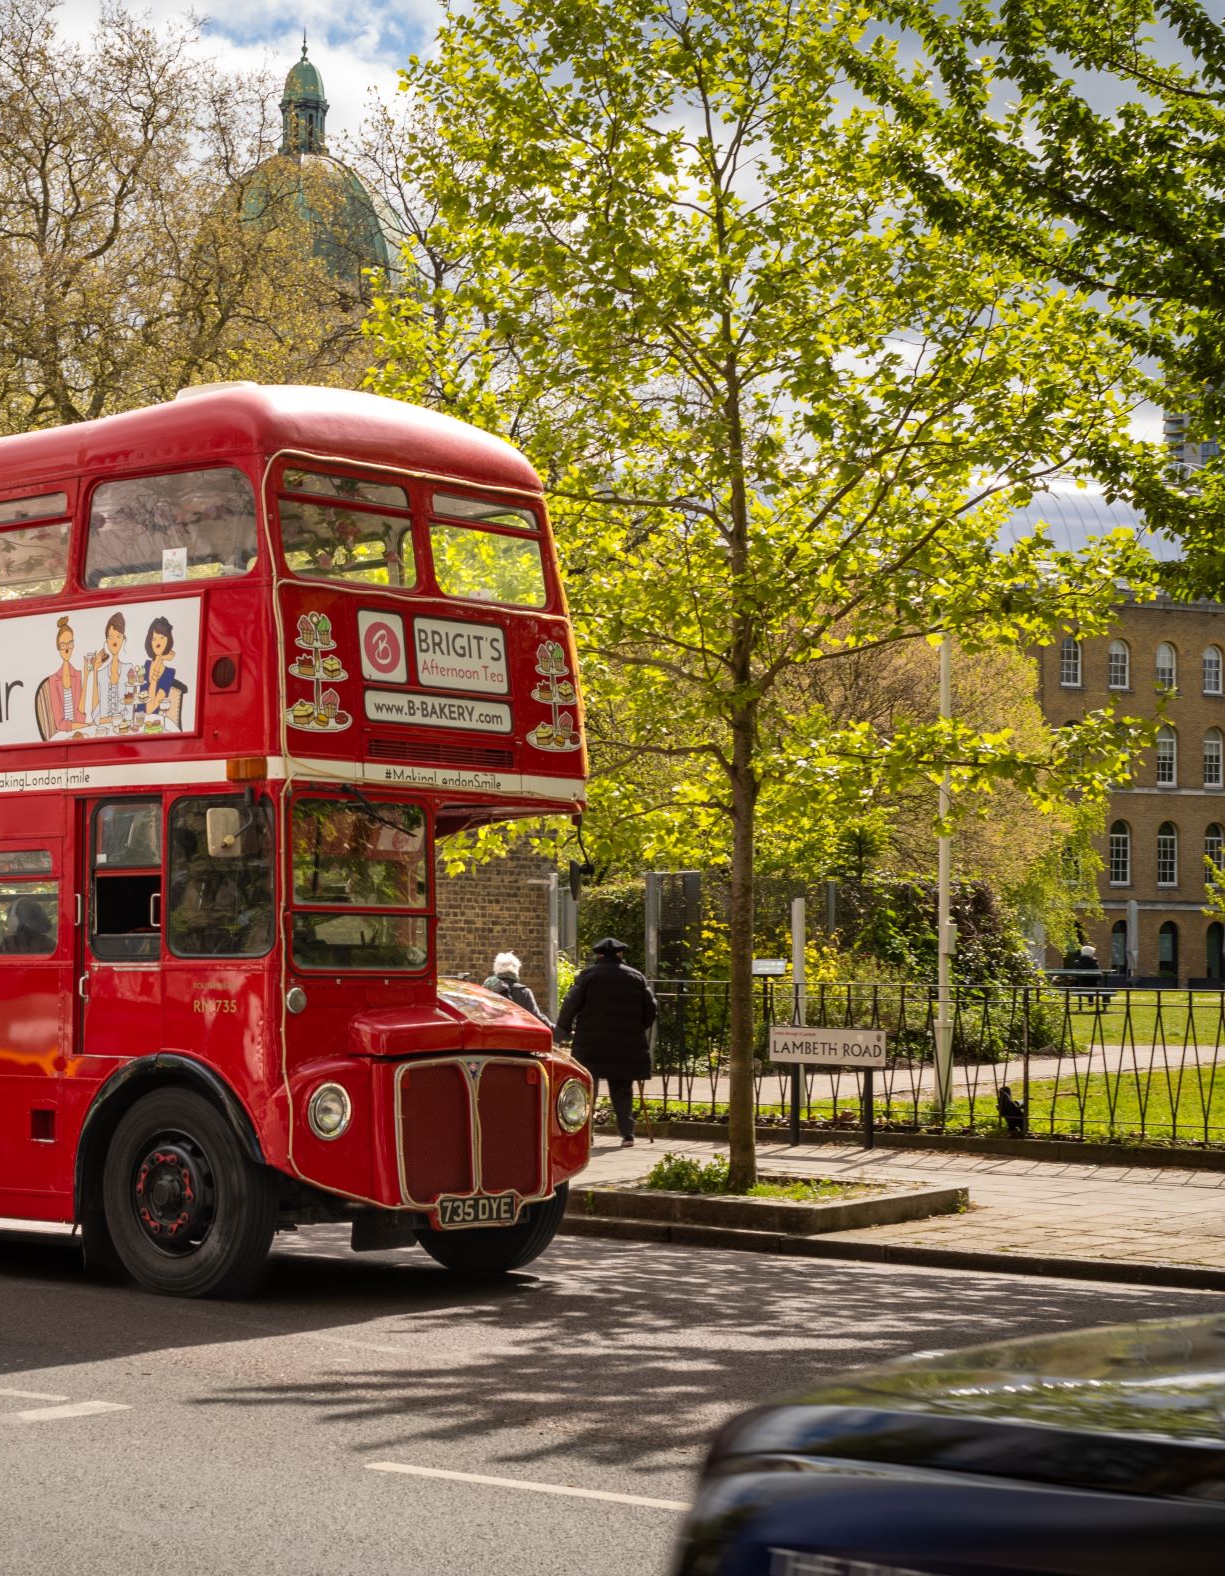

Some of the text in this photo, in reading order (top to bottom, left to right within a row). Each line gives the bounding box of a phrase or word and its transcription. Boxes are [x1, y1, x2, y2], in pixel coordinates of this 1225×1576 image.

[417, 628, 502, 662] BRIGIT'S
[421, 658, 504, 683] Afternoon Tea
[374, 700, 503, 725] www.B-BAKERY.com
[773, 1040, 882, 1058] LAMBETH ROAD
[442, 1197, 511, 1223] 735 DYE
